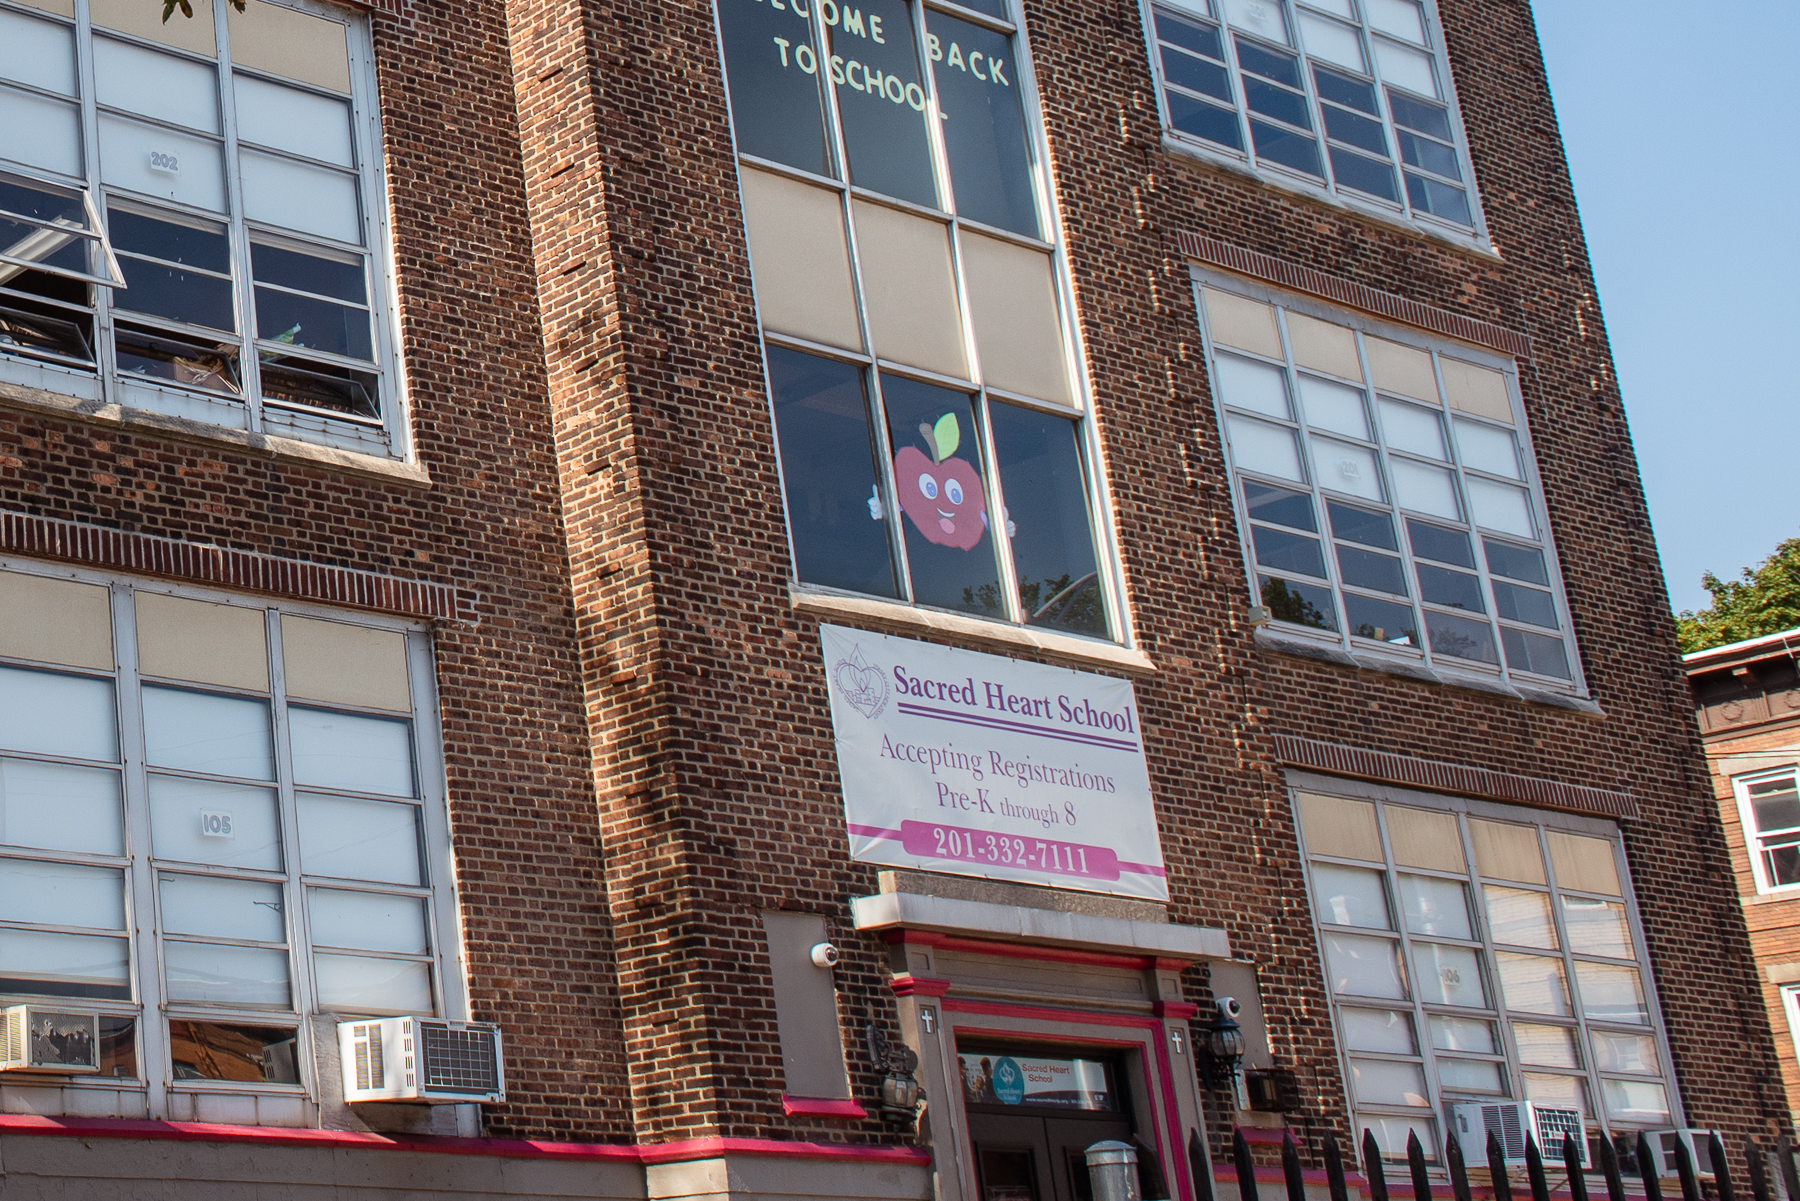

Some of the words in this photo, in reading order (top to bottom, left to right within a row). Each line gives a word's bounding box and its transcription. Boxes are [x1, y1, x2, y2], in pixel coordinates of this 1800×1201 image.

[773, 36, 817, 75] TO
[927, 33, 1009, 87] BACK
[151, 151, 179, 171] 202
[893, 664, 977, 706] Sacred
[982, 680, 1054, 720] Heart
[1058, 694, 1135, 734] School
[880, 733, 983, 782] Accepting
[988, 749, 1116, 794] Registrations
[203, 813, 232, 835] 105
[935, 781, 996, 815] Pre-K
[1000, 797, 1060, 829] through
[1063, 800, 1077, 826] 8
[933, 827, 1089, 874] 201-332-7111
[1021, 1063, 1048, 1074] Sacred
[1049, 1065, 1071, 1075] Heart
[1028, 1073, 1054, 1084] School
